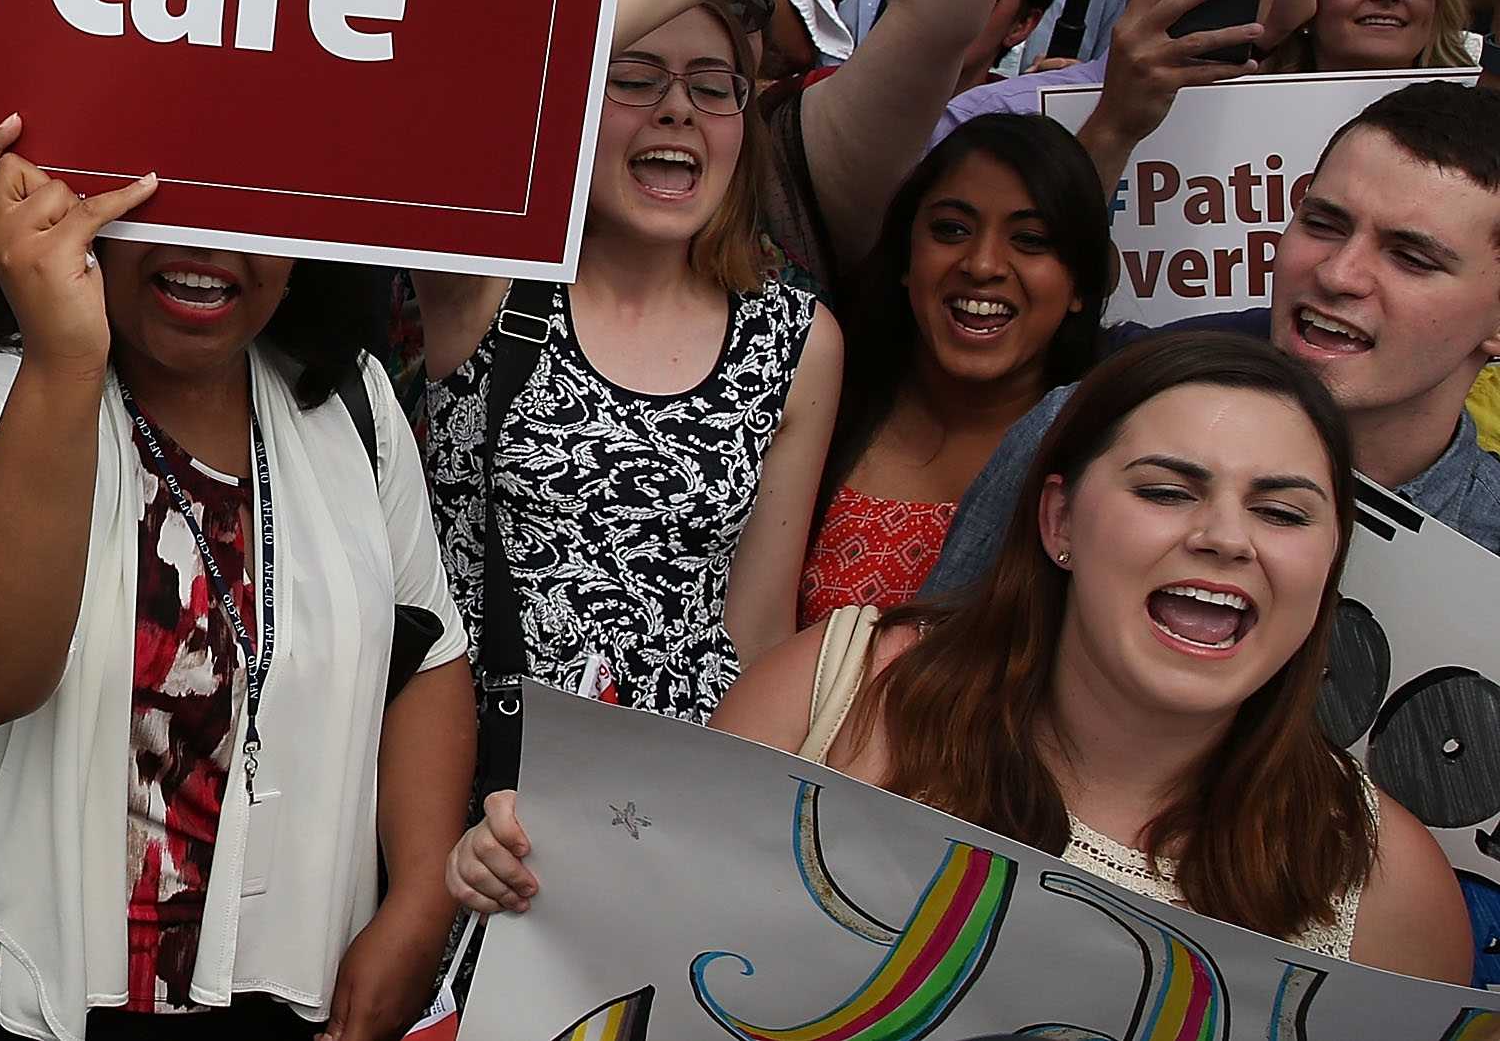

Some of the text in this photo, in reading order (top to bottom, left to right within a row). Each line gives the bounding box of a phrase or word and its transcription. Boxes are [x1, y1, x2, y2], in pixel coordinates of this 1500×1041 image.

[1102, 230, 1284, 298] verP
[135, 415, 165, 459] AFL-CIO
[166, 474, 194, 518] AFL-CIO
[262, 499, 274, 545] AFL-CIO
[196, 533, 222, 578] AFL-CIO
[264, 561, 274, 608] AFL-CIO
[222, 594, 249, 638] AFL-CIO
[261, 623, 274, 671] AFL-CIO
